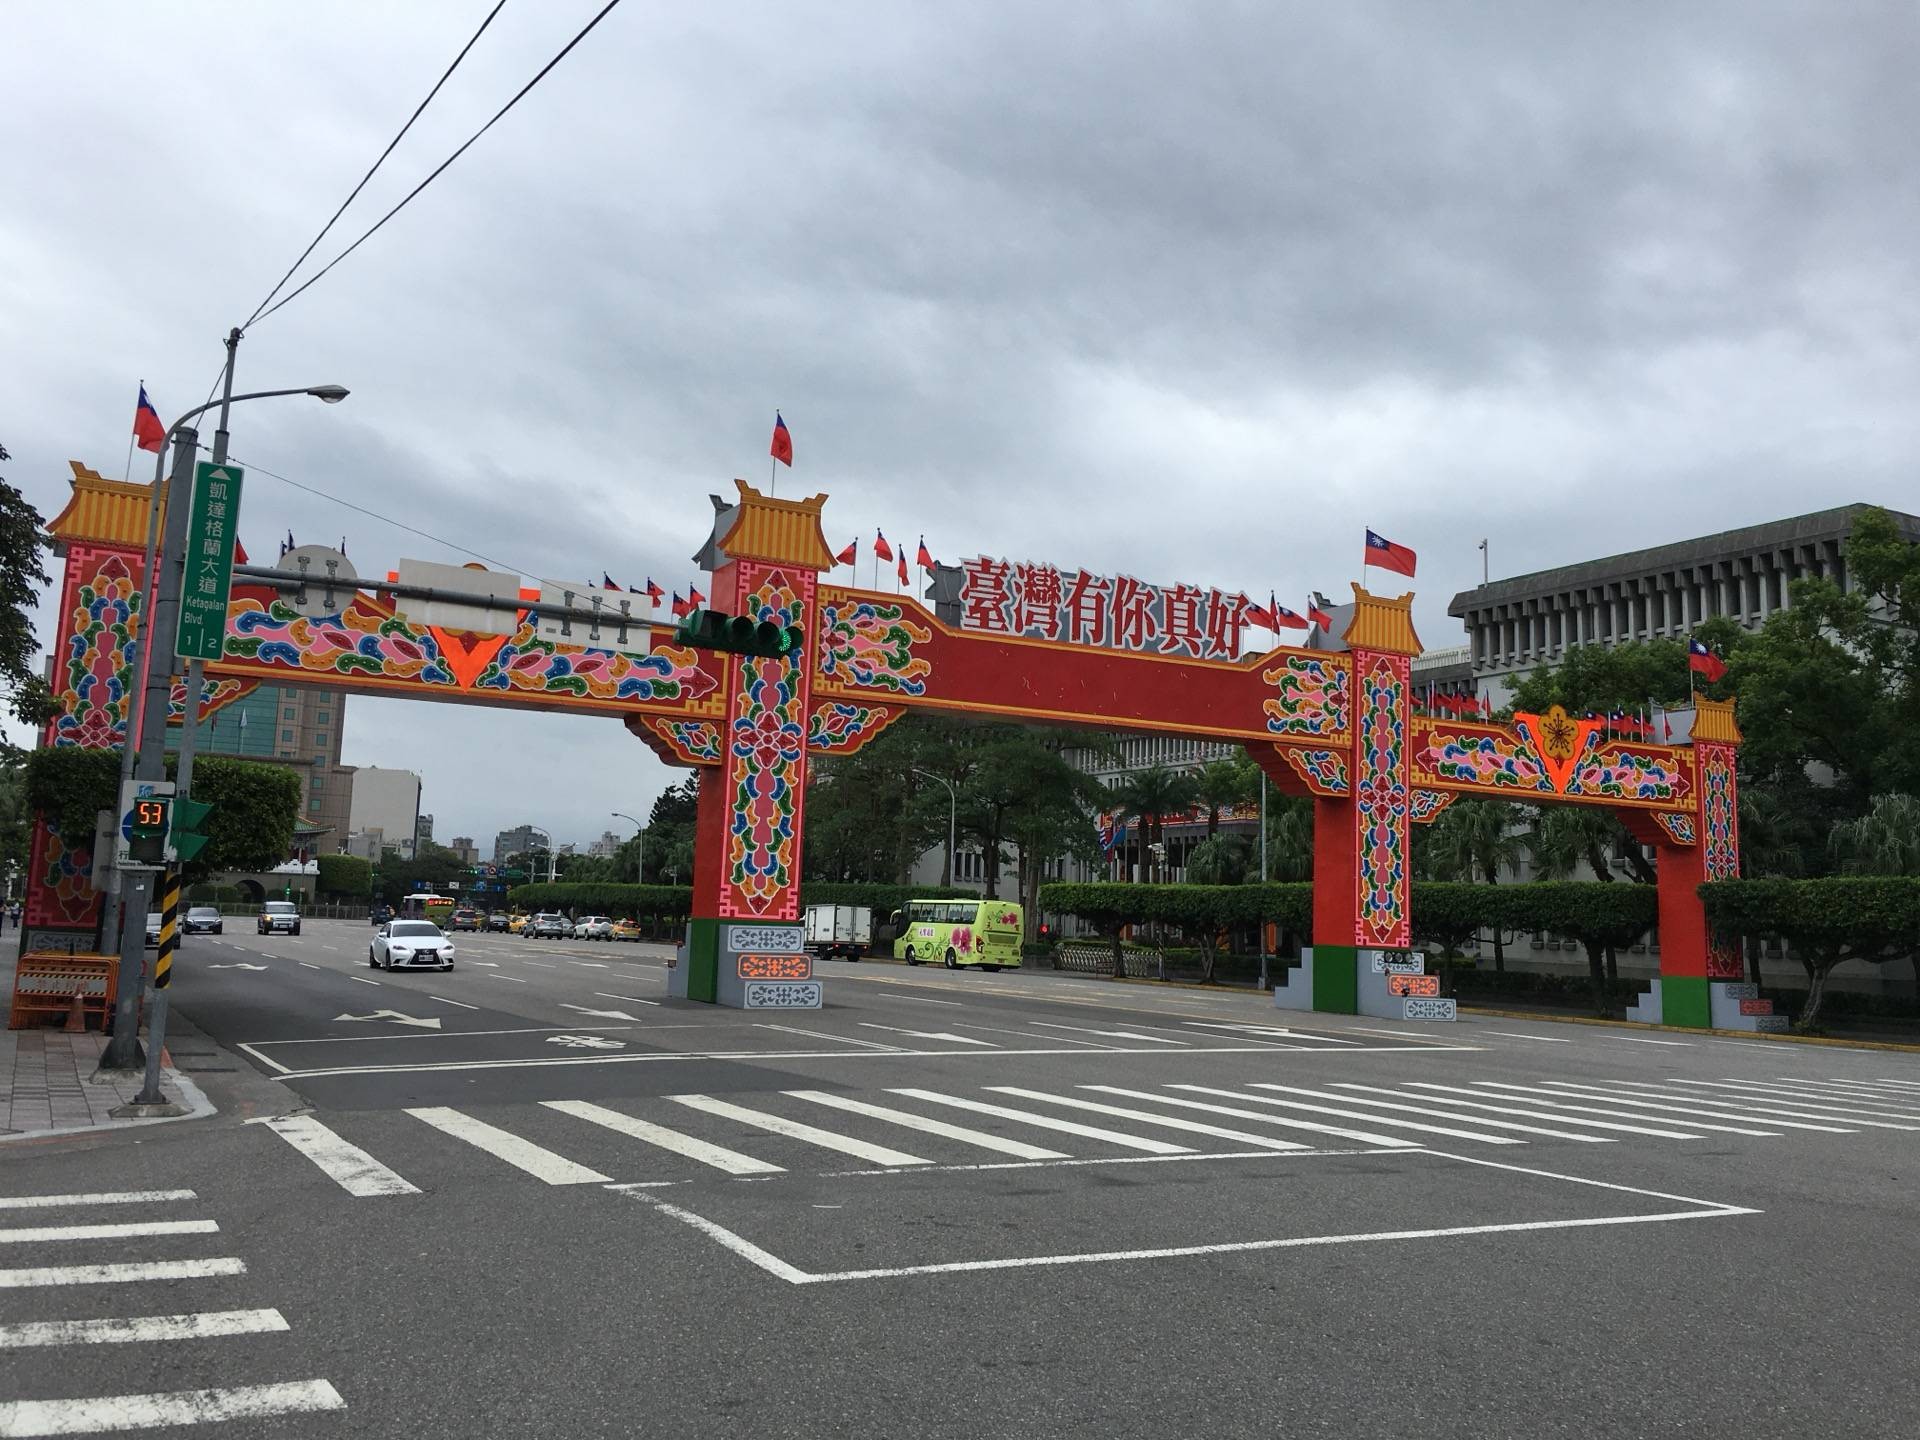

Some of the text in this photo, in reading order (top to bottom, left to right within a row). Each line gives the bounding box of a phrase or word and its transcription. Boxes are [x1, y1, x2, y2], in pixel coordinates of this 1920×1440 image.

[198, 482, 228, 595] 凱達格蘭大道
[186, 595, 225, 612] Ketagalan
[960, 555, 1251, 662] 臺灣有你真好
[184, 612, 204, 625] Blvd.
[186, 635, 217, 649] 1 2
[140, 802, 162, 825] 53
